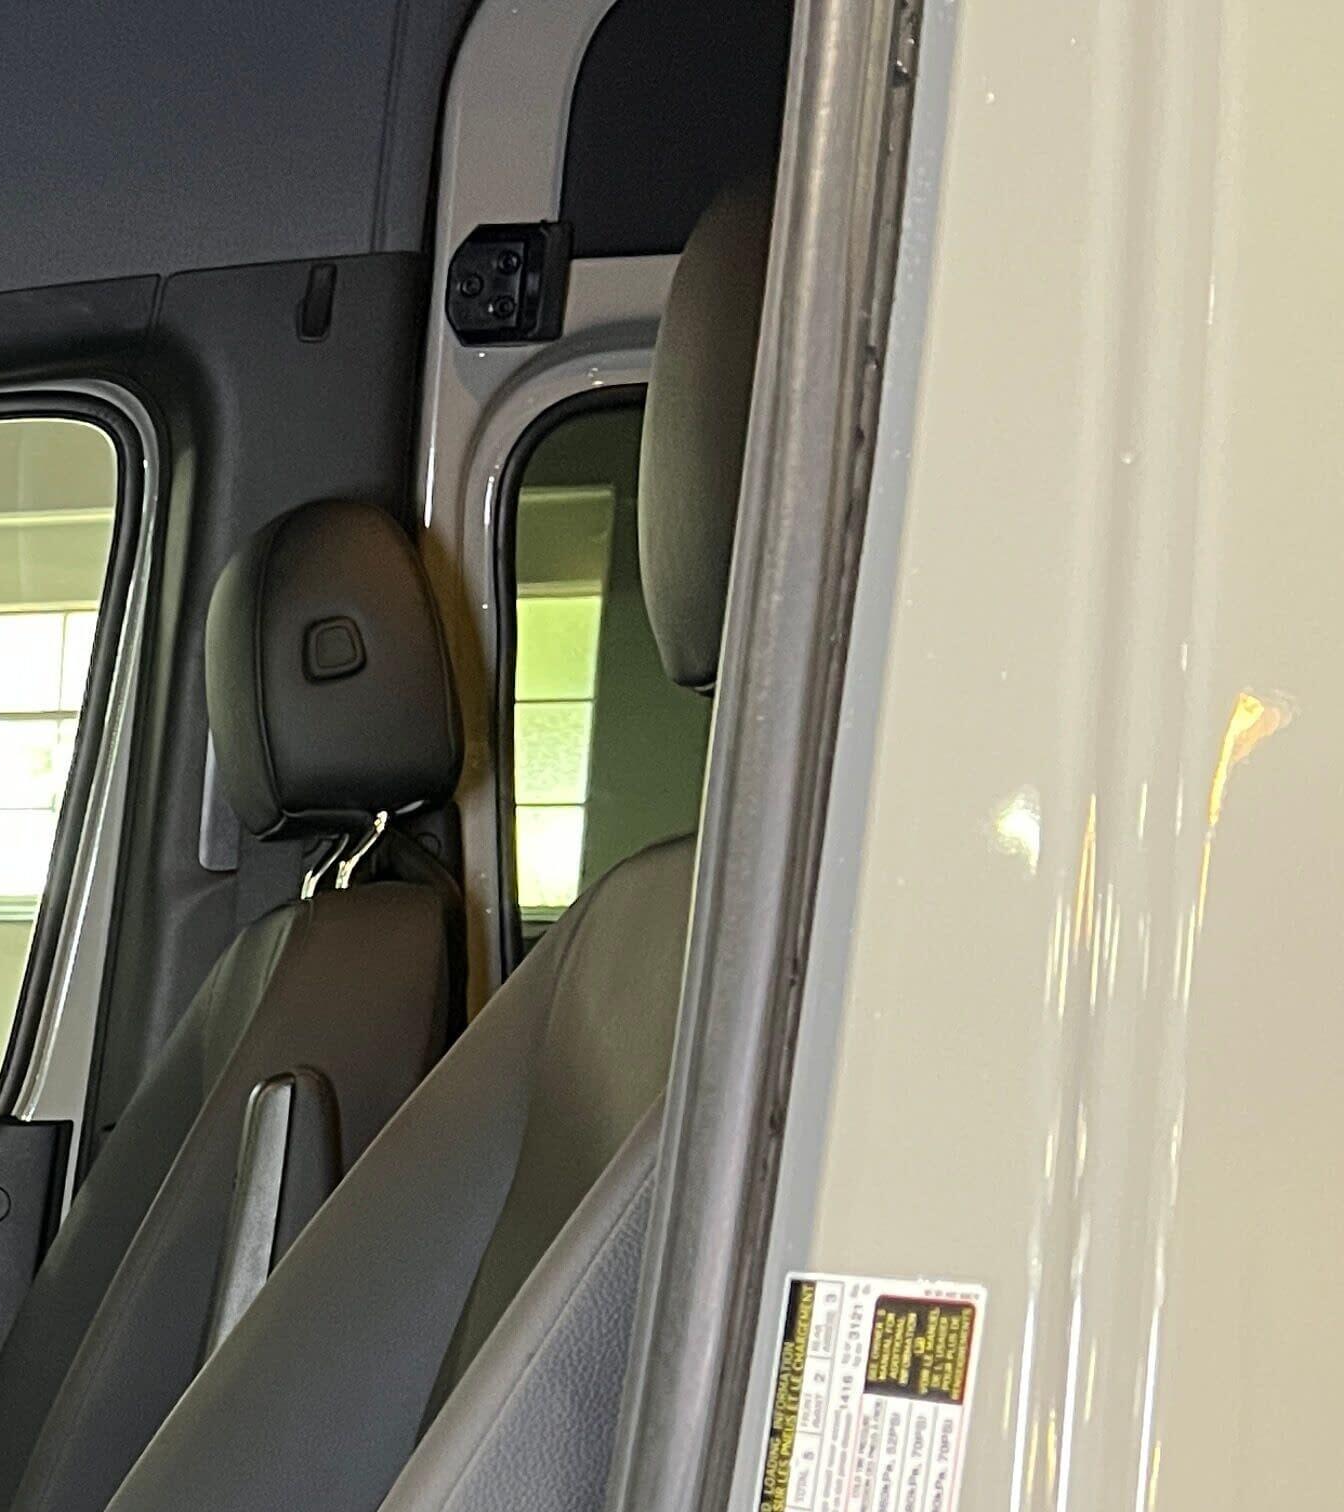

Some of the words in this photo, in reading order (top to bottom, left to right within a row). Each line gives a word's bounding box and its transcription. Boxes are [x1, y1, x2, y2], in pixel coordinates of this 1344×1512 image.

[792, 1285, 815, 1371] CHARGEMENT
[870, 1308, 885, 1359] OWNERS
[763, 1437, 781, 1493] LOADING
[772, 1341, 794, 1428] INFORMATION
[780, 1414, 796, 1455] PNEUS
[776, 1458, 790, 1483] LES
[772, 1485, 786, 1511] SUR
